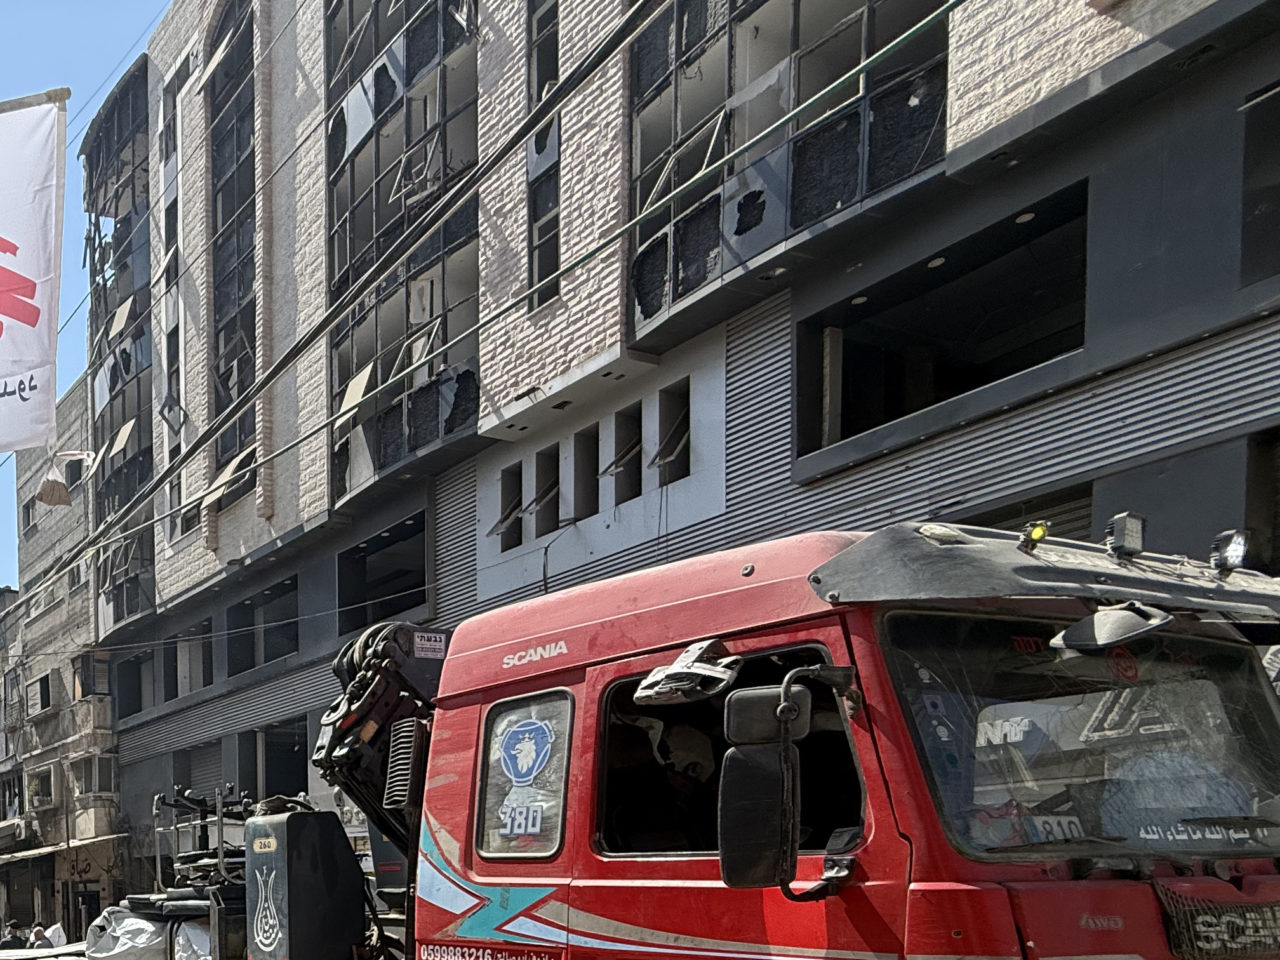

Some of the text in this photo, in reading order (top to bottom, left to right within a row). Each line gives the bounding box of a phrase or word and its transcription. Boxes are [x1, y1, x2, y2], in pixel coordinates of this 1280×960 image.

[501, 640, 568, 669] SCANIA
[498, 805, 544, 837] 380
[1138, 825, 1164, 840] الله
[1204, 824, 1228, 840] الله
[258, 840, 272, 850] 260
